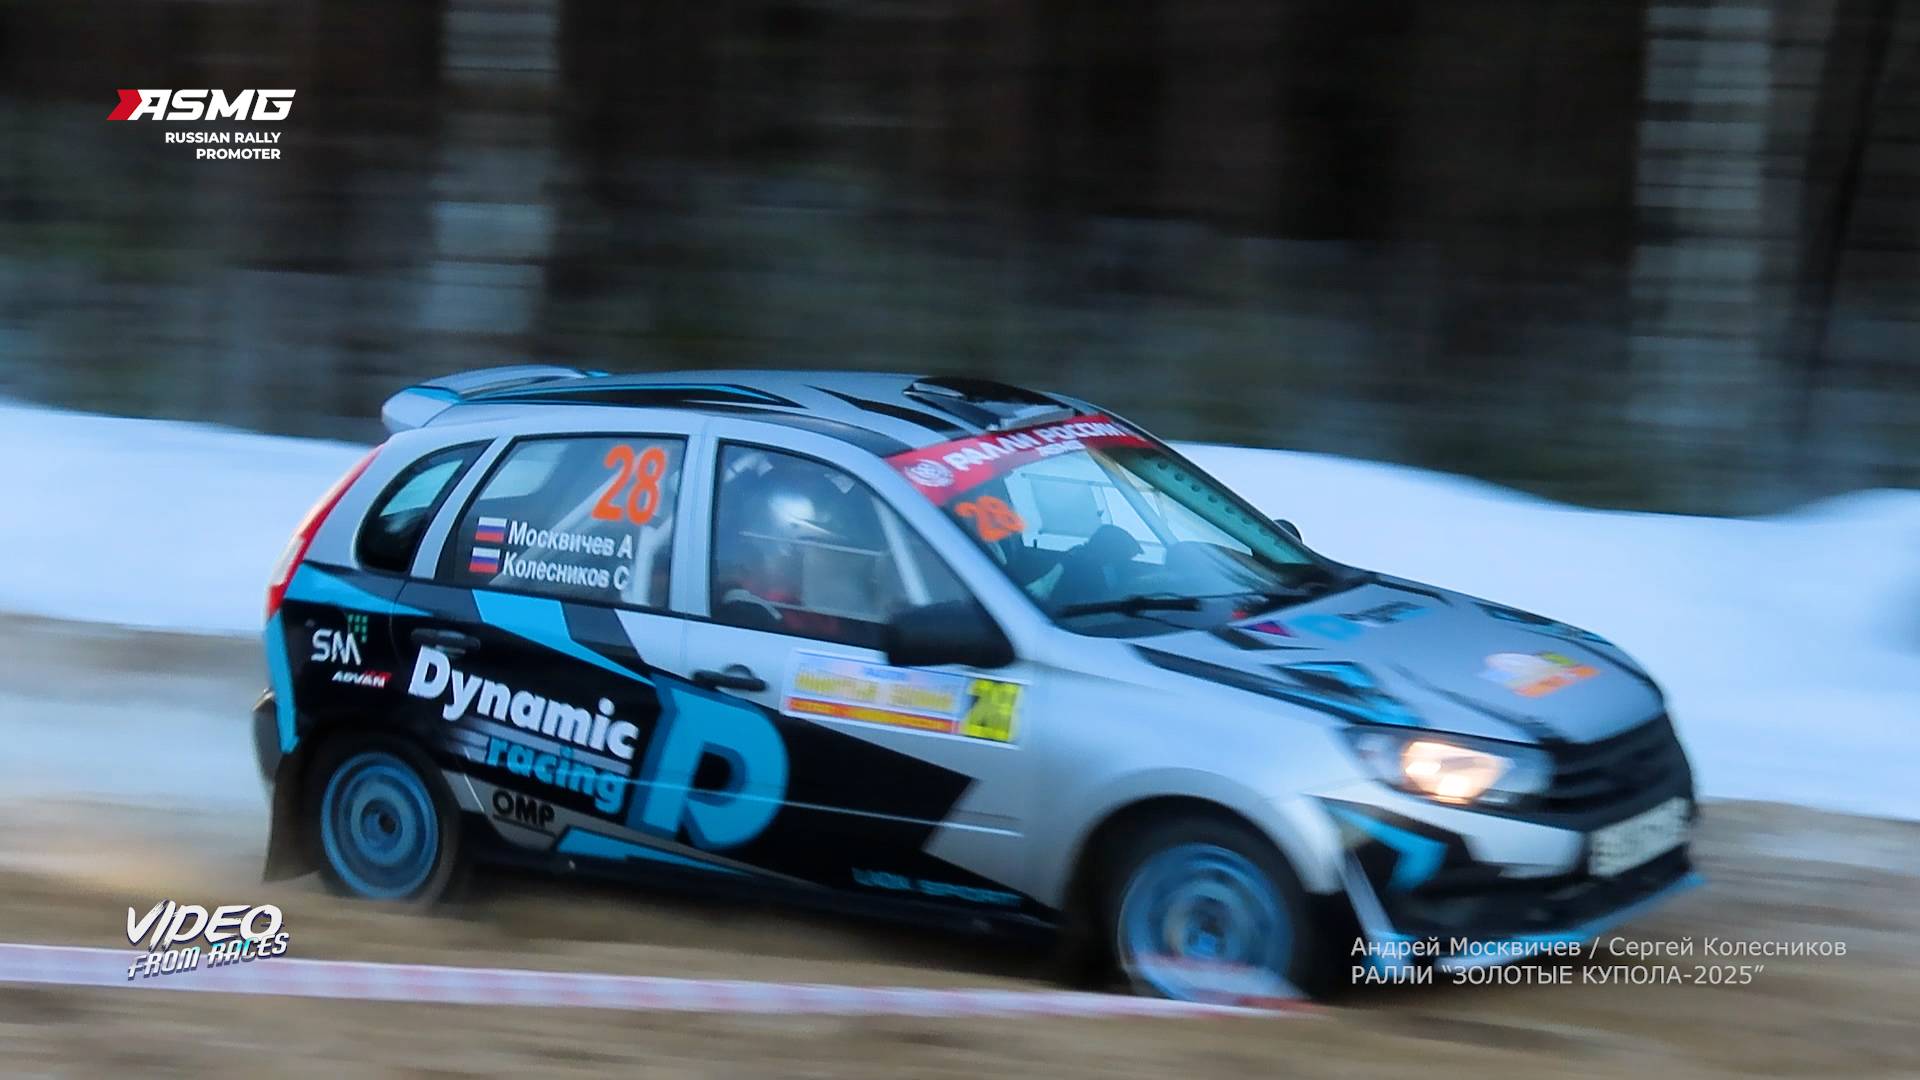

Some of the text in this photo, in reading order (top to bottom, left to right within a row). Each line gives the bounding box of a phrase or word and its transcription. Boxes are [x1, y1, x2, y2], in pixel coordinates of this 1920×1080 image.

[943, 433, 1042, 471] РАЛЛИ
[592, 444, 667, 525] 28
[508, 520, 615, 557] Москвичев
[501, 552, 610, 588] Колесников
[331, 670, 386, 689] ADVAN
[408, 645, 639, 760] Dynamic
[486, 738, 627, 814] racing
[492, 790, 555, 828] OMP
